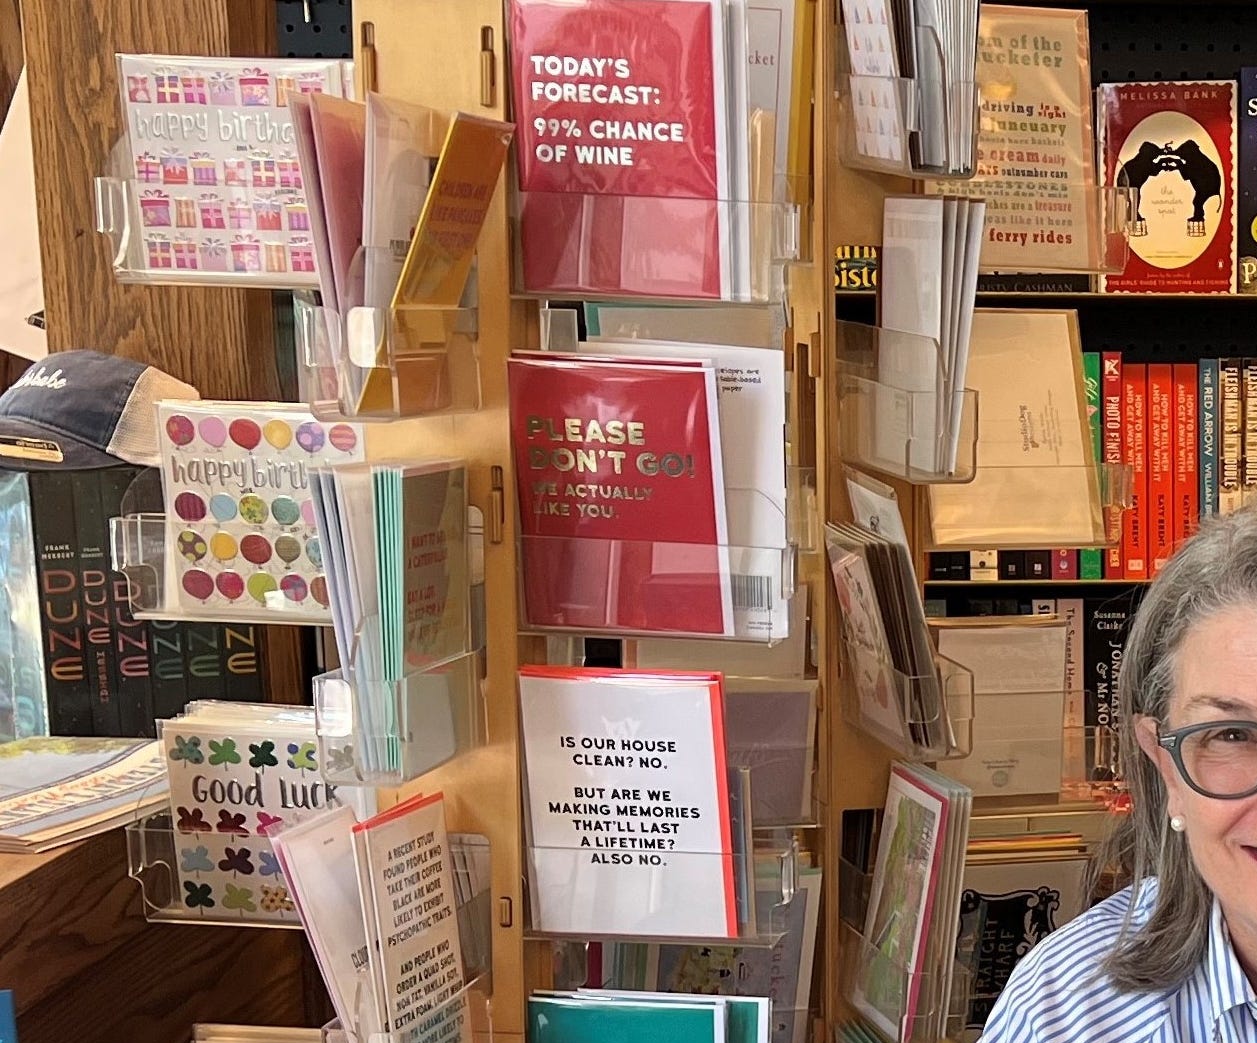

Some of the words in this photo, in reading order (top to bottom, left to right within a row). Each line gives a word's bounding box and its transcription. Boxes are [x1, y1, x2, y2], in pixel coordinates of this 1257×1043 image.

[531, 55, 630, 79] TODAY'S
[531, 82, 660, 105] FORECAST:
[1120, 91, 1176, 101] MELISSA
[1184, 90, 1218, 99] BANK
[136, 109, 208, 142] happy
[533, 118, 581, 138] 99%
[589, 120, 684, 142] CHANCE
[535, 144, 567, 163] OF
[574, 145, 633, 166] WINE
[989, 228, 1027, 245] ferry
[1032, 228, 1072, 244] rides
[1204, 385, 1213, 407] RED
[1107, 396, 1119, 429] PHOTO
[526, 415, 645, 446] PLEASE
[1204, 412, 1213, 456] ARROW
[171, 454, 244, 487] happy
[529, 447, 626, 474] DON'T
[636, 453, 696, 478] GO!
[532, 481, 557, 497] WE
[565, 484, 653, 500] ACTUALLY
[534, 503, 570, 516] LIKE
[577, 503, 620, 519] YOU.
[43, 570, 83, 682] DUNE
[560, 736, 576, 749] IS
[581, 737, 615, 750] OUR
[622, 739, 676, 753] HOUSE
[573, 754, 634, 767] CLEAN?
[639, 757, 668, 769] NO.
[574, 787, 605, 799] BUT
[611, 789, 641, 801] ARE
[647, 790, 671, 801] WE
[548, 802, 610, 815] MAKING
[617, 805, 701, 819] MEMORIES
[573, 820, 635, 832] THAT'LL
[641, 822, 679, 834] LAST
[580, 836, 590, 847] A
[595, 837, 675, 850] LIFETIME?
[591, 854, 633, 865] ALSO
[639, 855, 668, 866] NO.
